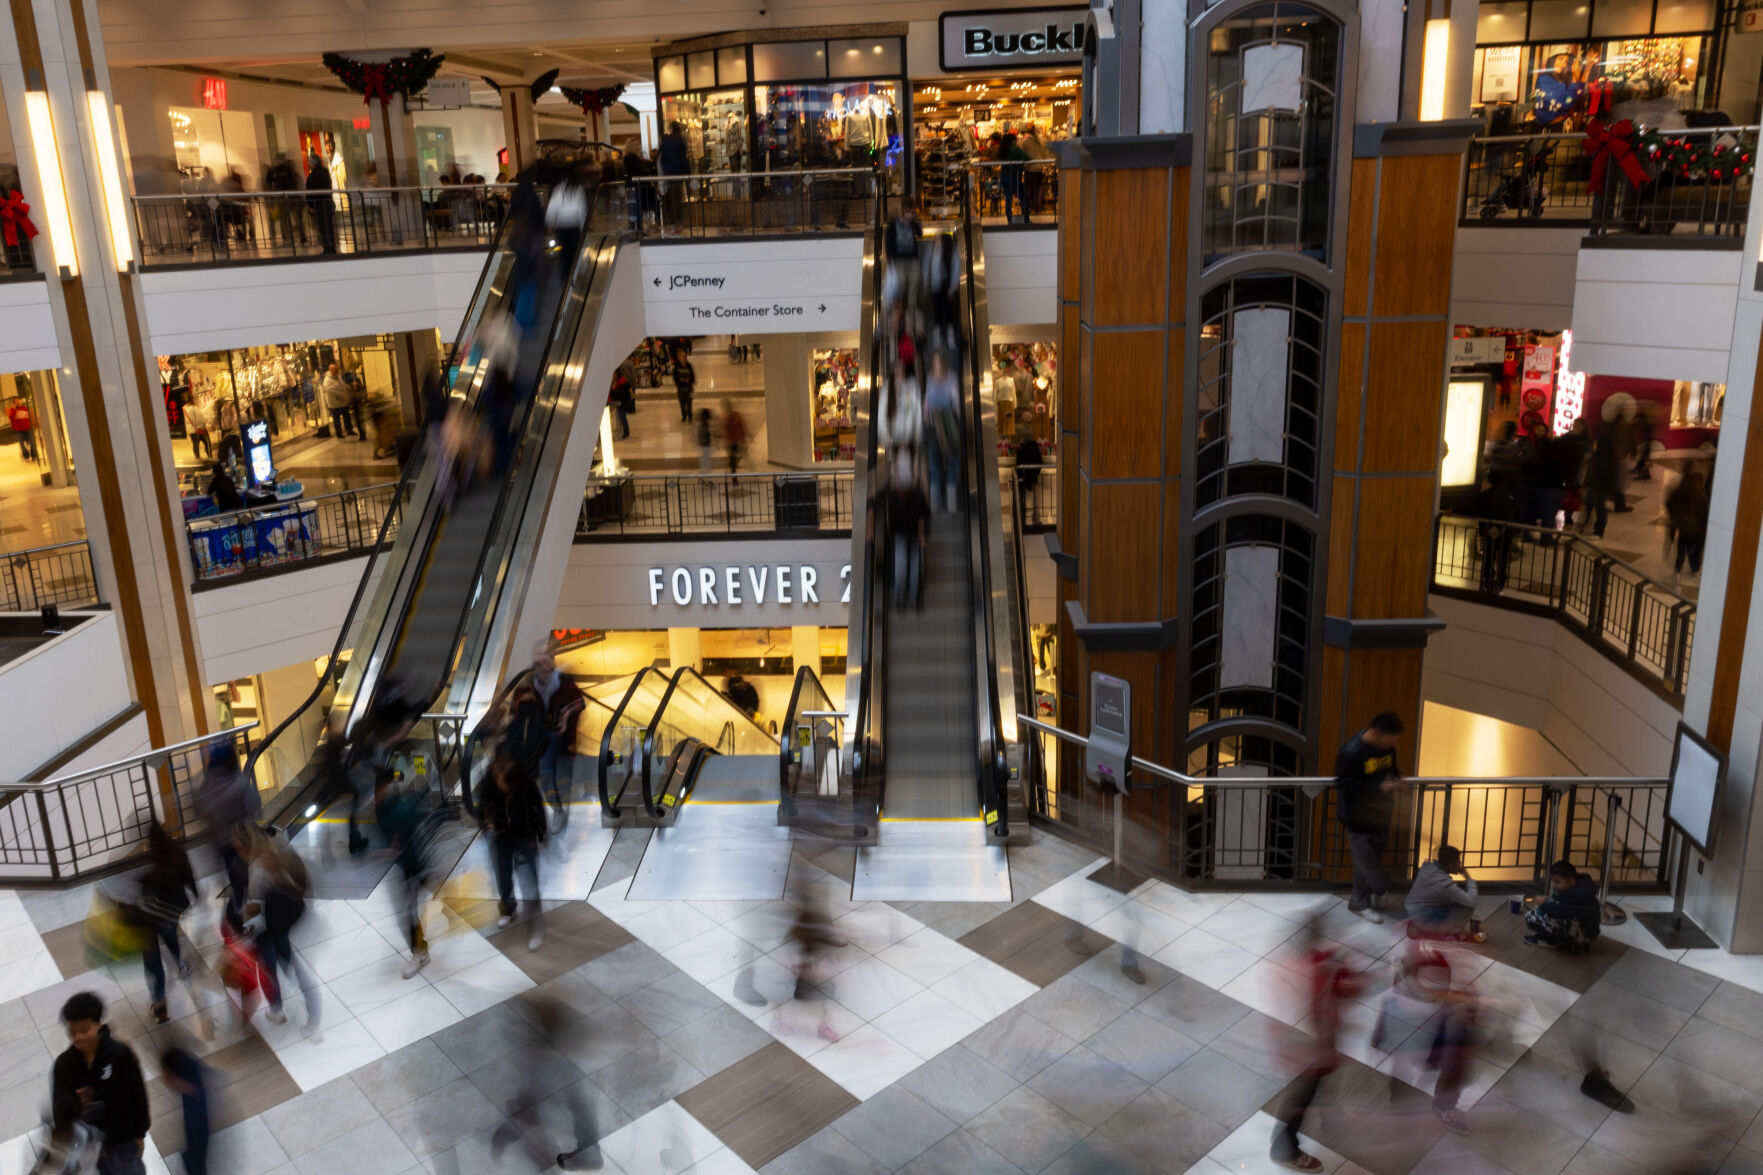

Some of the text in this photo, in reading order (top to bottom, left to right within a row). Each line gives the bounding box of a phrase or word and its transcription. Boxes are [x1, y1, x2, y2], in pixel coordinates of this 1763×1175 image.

[964, 23, 1085, 57] Buckl
[669, 275, 726, 291] JCPenney
[689, 303, 803, 319] The Container Store
[648, 564, 851, 606] FOREVER 2
